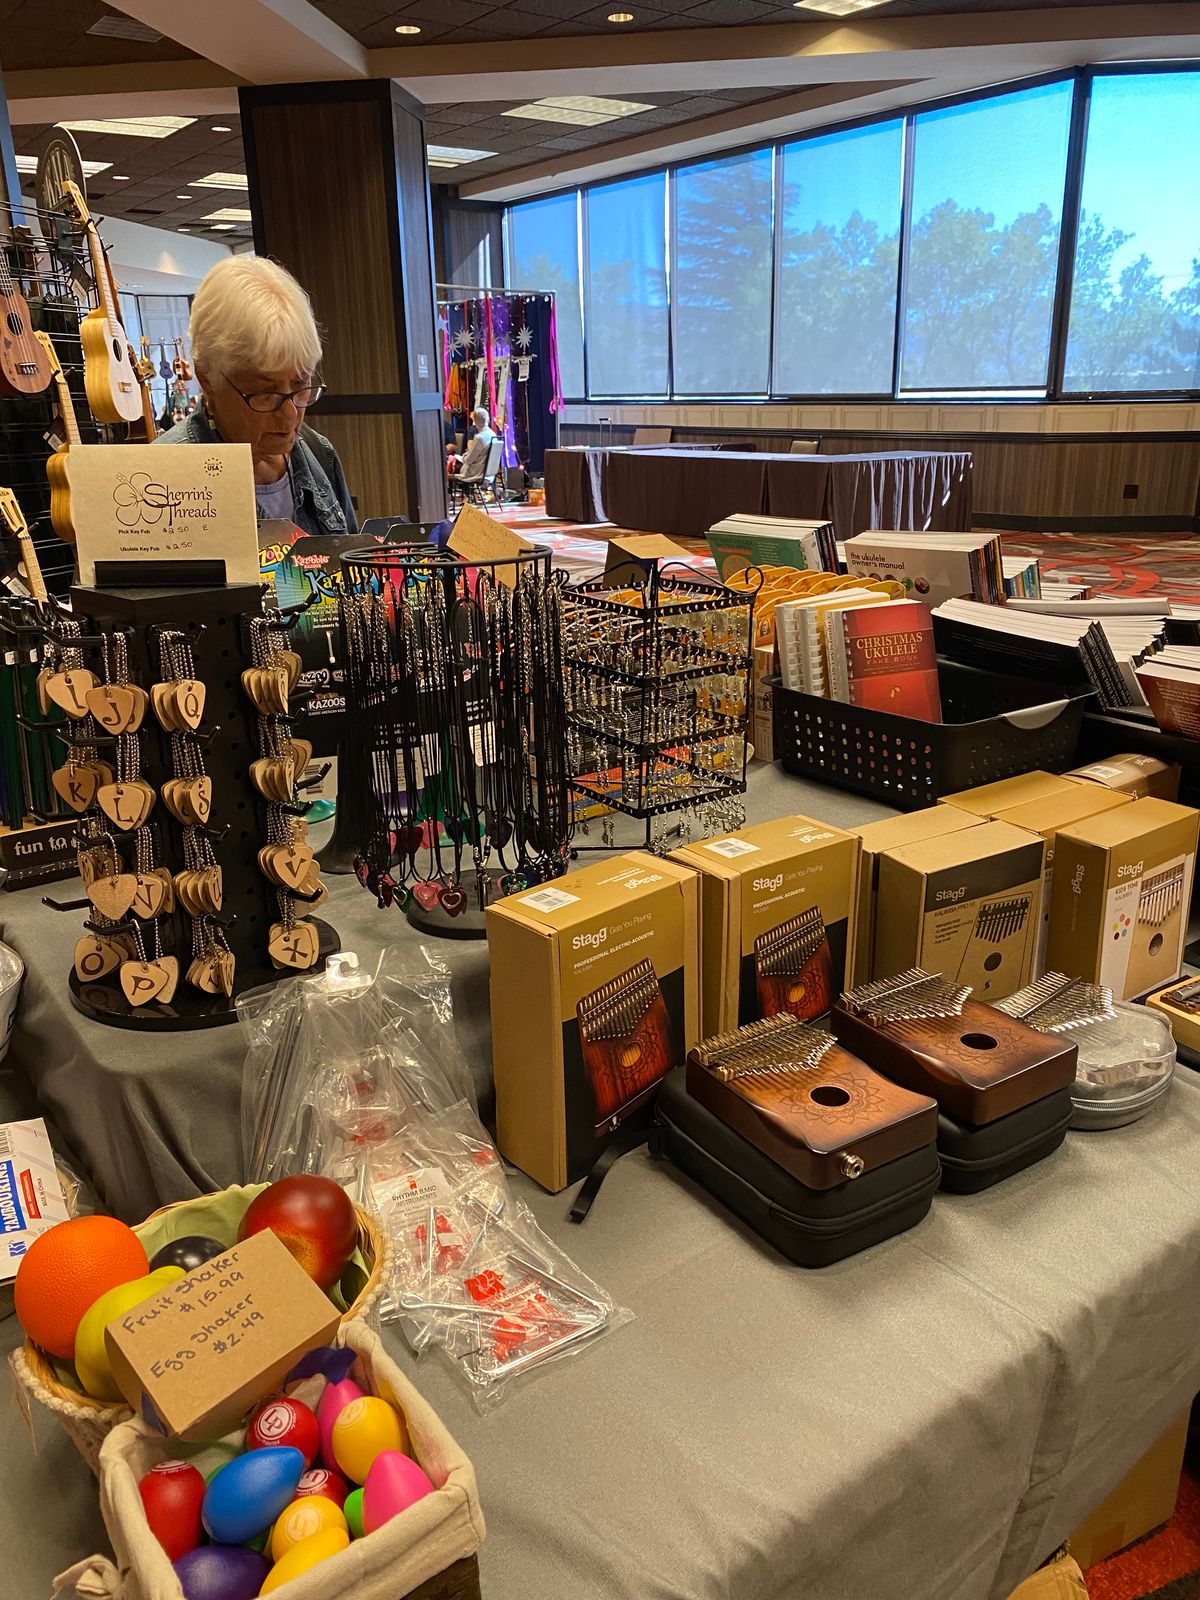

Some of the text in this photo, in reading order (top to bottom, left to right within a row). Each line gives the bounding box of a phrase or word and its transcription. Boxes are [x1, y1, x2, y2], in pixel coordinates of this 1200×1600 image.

[143, 483, 213, 508] Sherrin's
[163, 501, 217, 527] Threads
[850, 552, 886, 562] the ukulele
[851, 559, 905, 570] owner's manual
[856, 631, 923, 650] CHRISTMAS
[864, 643, 918, 659] UKULELE
[866, 654, 919, 666] FAKE BOOK
[102, 702, 121, 726] J
[184, 693, 201, 720] Q
[308, 697, 346, 709] KAZOOS
[68, 781, 88, 804] K
[198, 789, 210, 816] S
[113, 796, 135, 823] L
[14, 841, 44, 856] fun
[284, 857, 307, 878] V
[1072, 863, 1085, 895] Stagg
[1117, 860, 1144, 878] Stagg
[752, 873, 783, 892] Stagg
[935, 886, 966, 902] Stagg
[1115, 886, 1127, 895] KIDS
[752, 887, 806, 910] PROFESSIONAL ACOUSTIC
[572, 926, 607, 950] Stagg
[623, 920, 634, 929] You
[633, 912, 652, 925] Playing
[281, 937, 308, 963] X
[573, 930, 656, 970] PROFESSIONAL ELECTRO-ACOUSTIC
[80, 952, 105, 975] O
[131, 975, 156, 996] P
[391, 1185, 438, 1202] RHYTHM BAND
[395, 1192, 438, 1208] INSTRUMENTS
[122, 1251, 240, 1334] Fruit Shaker
[150, 1293, 255, 1379] Egg Shaker
[212, 1311, 265, 1354] $2.49
[264, 1408, 284, 1432] LP
